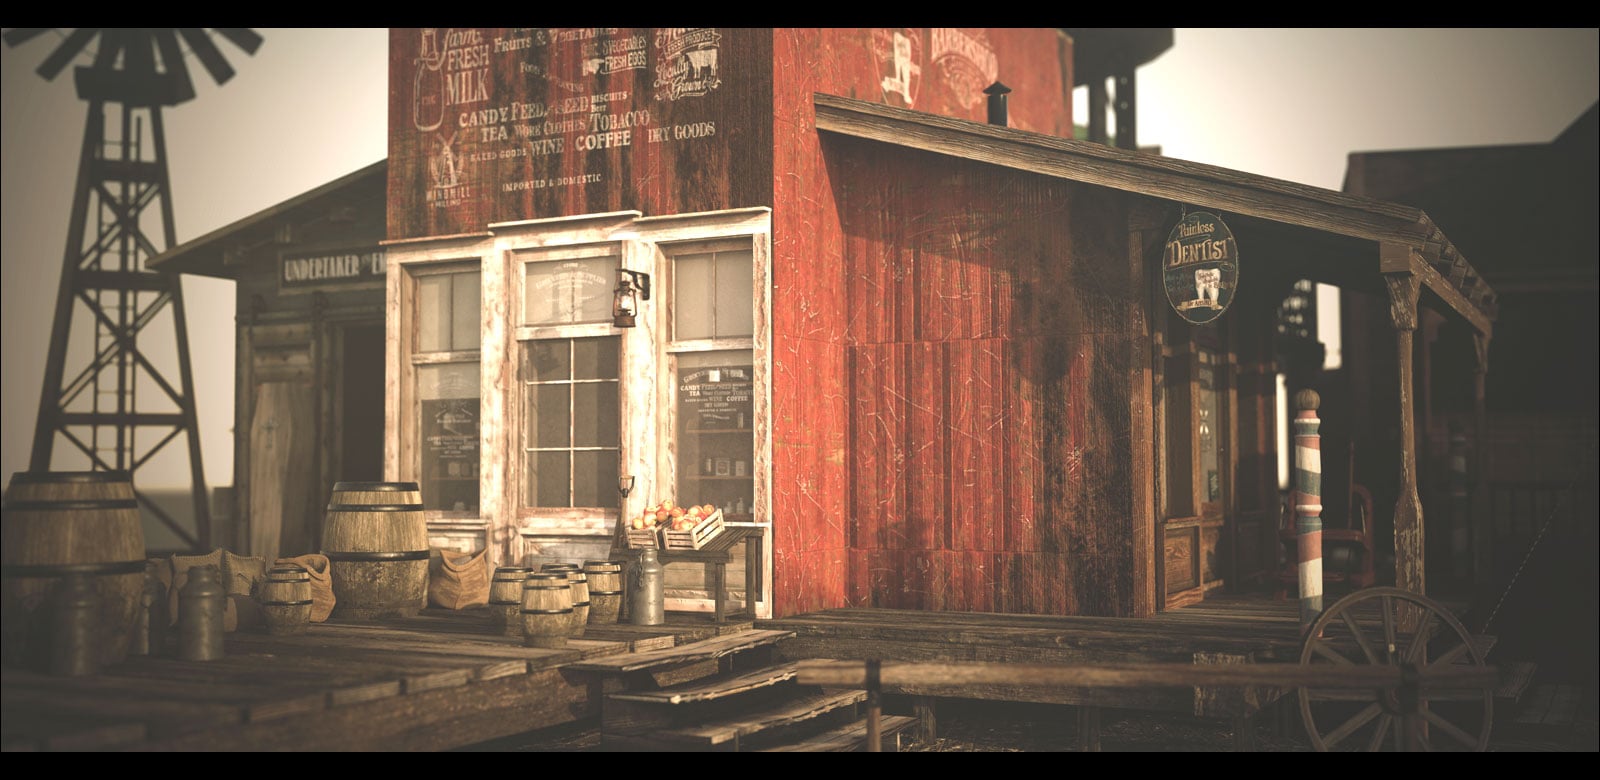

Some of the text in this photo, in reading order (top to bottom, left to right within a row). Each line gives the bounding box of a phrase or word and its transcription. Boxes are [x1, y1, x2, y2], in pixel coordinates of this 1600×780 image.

[447, 44, 490, 71] FRESH
[494, 37, 532, 53] FRUITS
[604, 54, 627, 72] FRESH
[627, 49, 647, 67] EGGS
[446, 68, 489, 106] MILK
[591, 91, 628, 104] BISCUITS
[459, 107, 508, 128] CANDY
[481, 126, 508, 142] TEA
[543, 119, 586, 136] CLOTHES
[590, 109, 650, 133] TOBACCO
[470, 121, 716, 162] BAKED GOODS WINE COFFEE DRY GOODS
[502, 180, 546, 193] IMPORTED
[557, 173, 602, 188] DOMESTIC
[1179, 221, 1215, 238] Painless
[1168, 239, 1229, 267] DENTIST
[285, 254, 359, 281] UNDERTAKER
